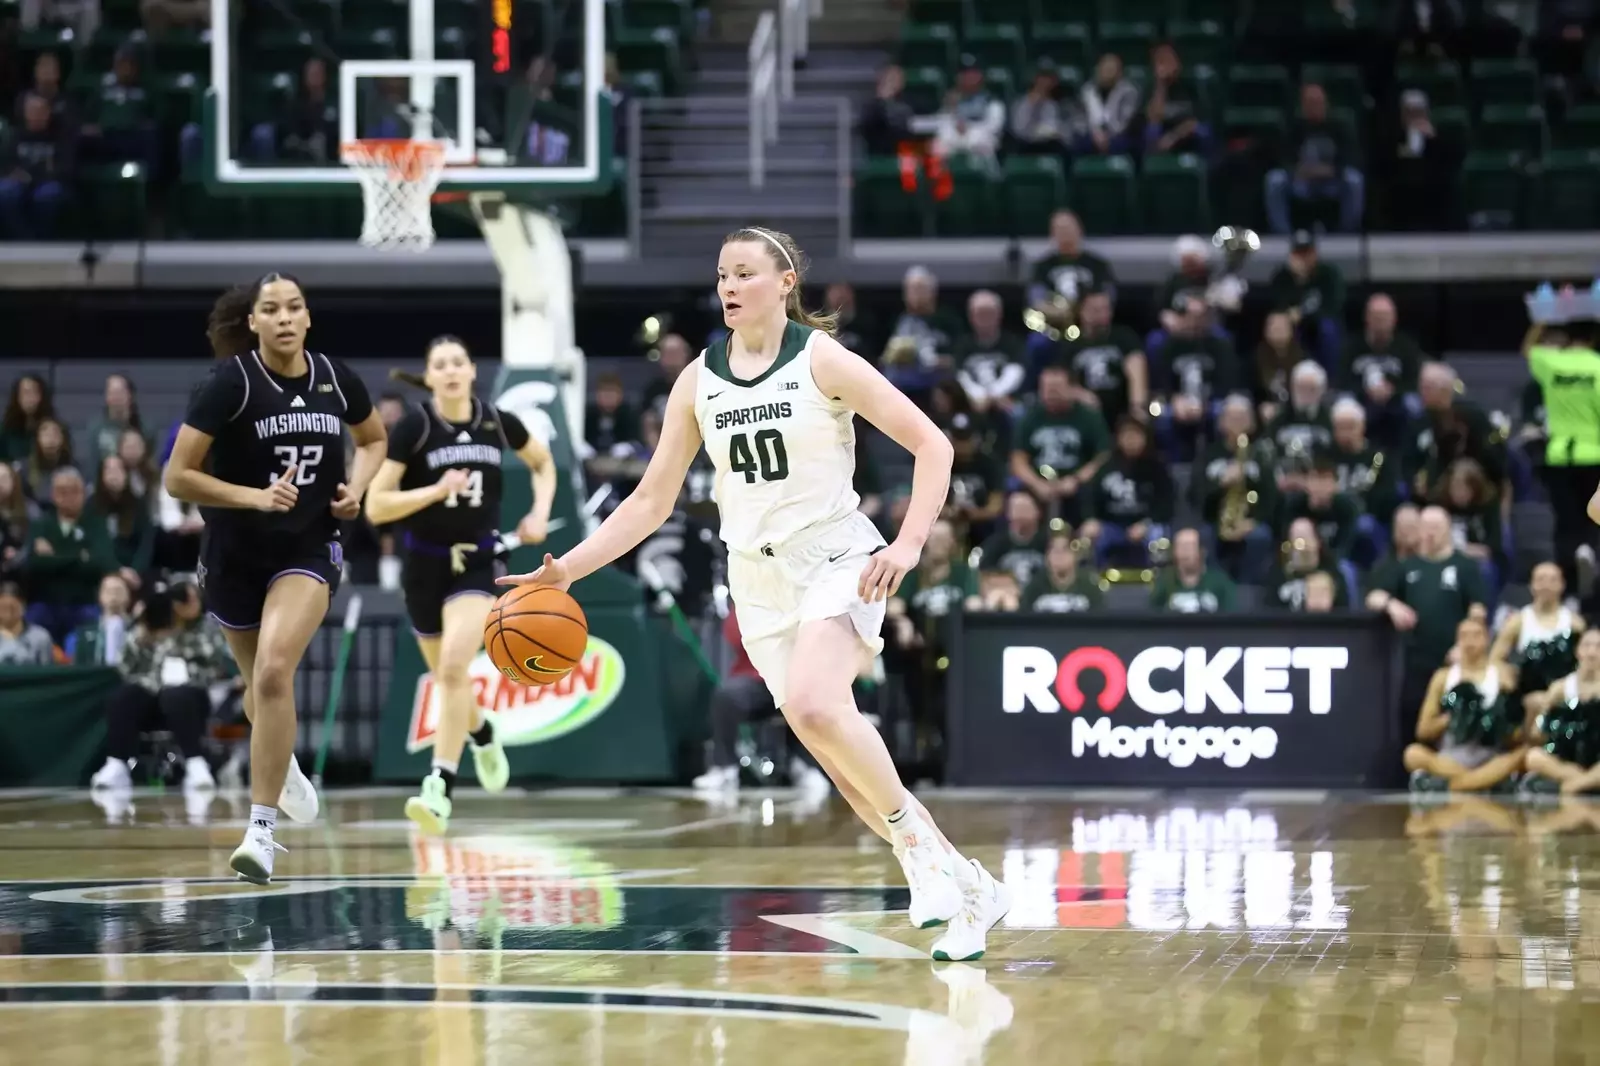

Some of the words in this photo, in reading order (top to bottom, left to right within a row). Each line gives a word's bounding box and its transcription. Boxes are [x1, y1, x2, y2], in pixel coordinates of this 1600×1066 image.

[255, 412, 340, 439] WASHINGTON
[715, 402, 792, 429] SPARTANS
[269, 445, 323, 486] 32
[729, 429, 789, 483] 40
[1002, 646, 1349, 714] ROCKET
[1071, 716, 1278, 768] Mortgage
